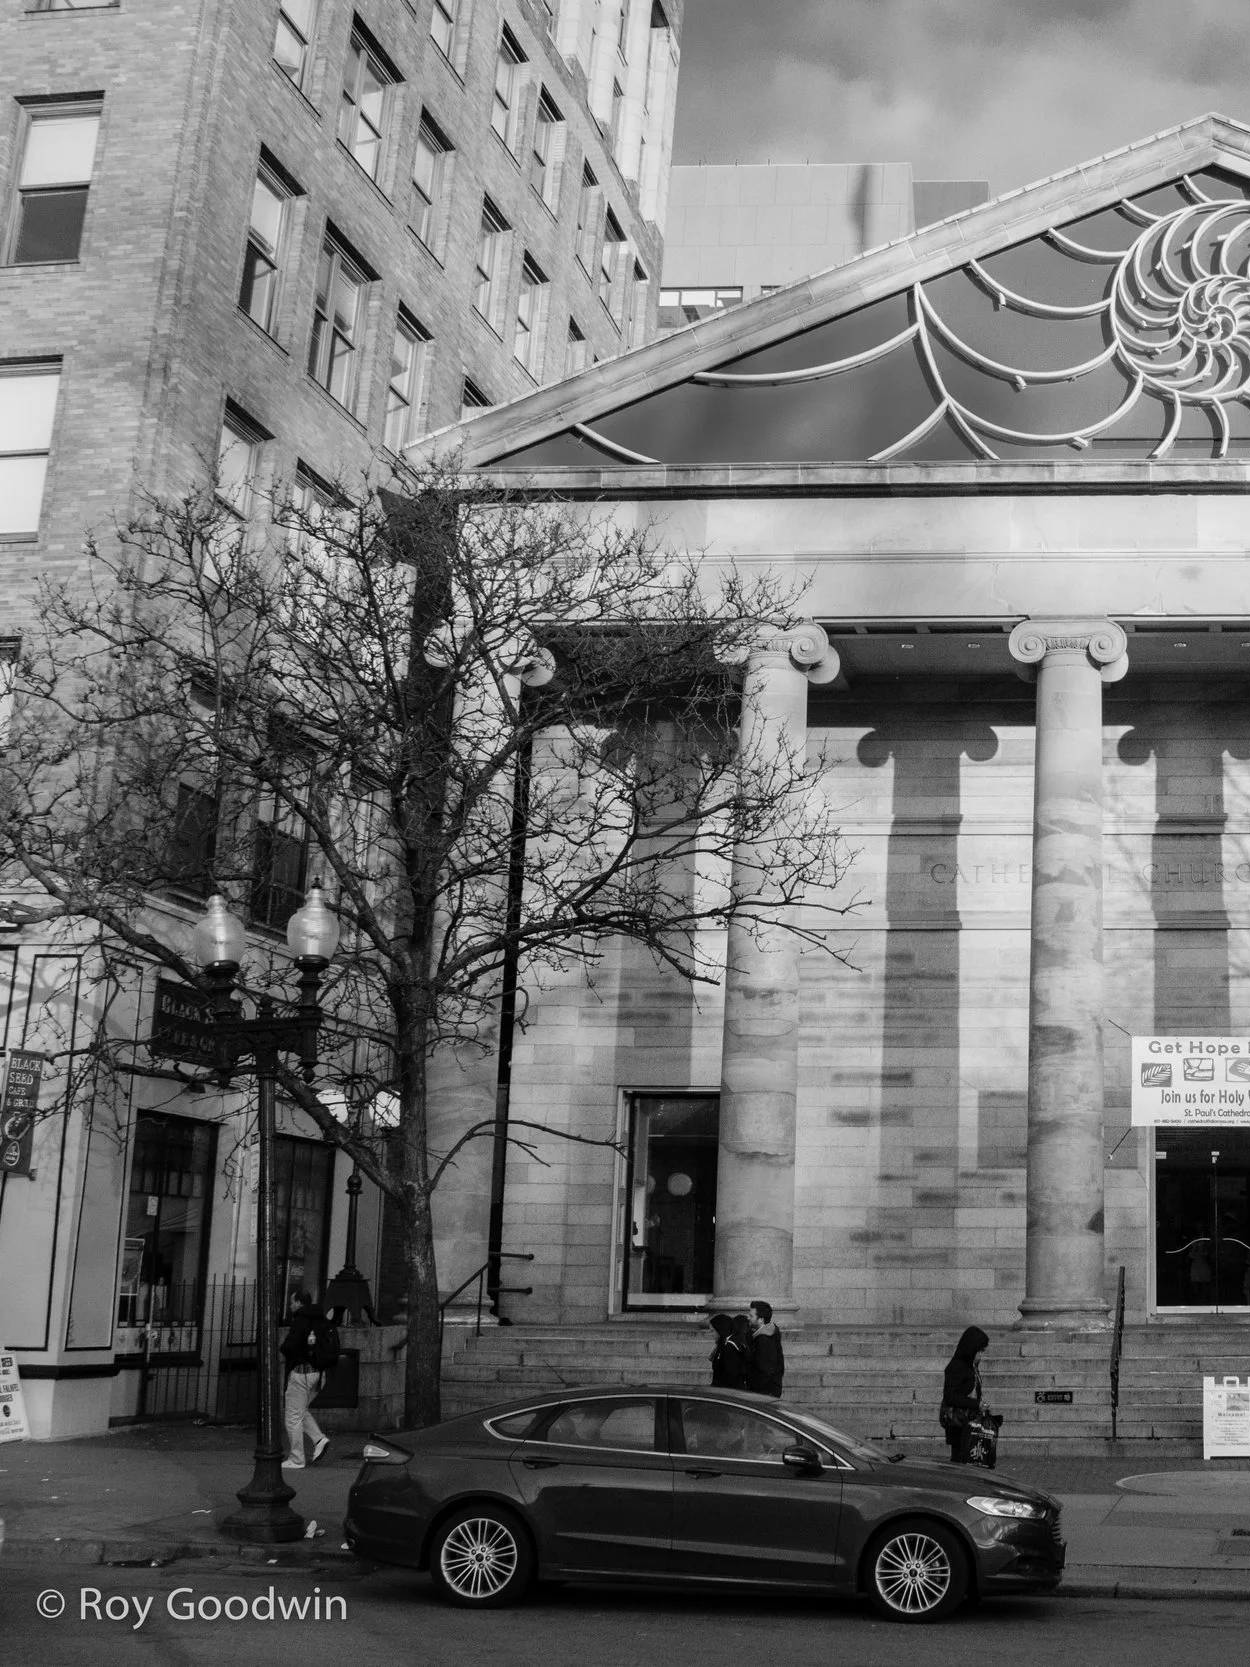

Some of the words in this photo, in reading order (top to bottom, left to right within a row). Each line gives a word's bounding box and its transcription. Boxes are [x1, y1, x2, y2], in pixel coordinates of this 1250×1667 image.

[930, 863, 1118, 884] CATHEL
[1148, 1041, 1182, 1054] Get
[1189, 1041, 1241, 1056] Hope
[11, 1057, 42, 1072] BLACK
[9, 1072, 34, 1085] SEED
[8, 1086, 26, 1096] CAFE
[1161, 1089, 1181, 1105] Join
[1185, 1092, 1197, 1104] us
[1200, 1090, 1216, 1104] for
[1219, 1090, 1245, 1107] Holy
[1184, 1109, 1193, 1117] St.
[1195, 1108, 1217, 1117] Paul's
